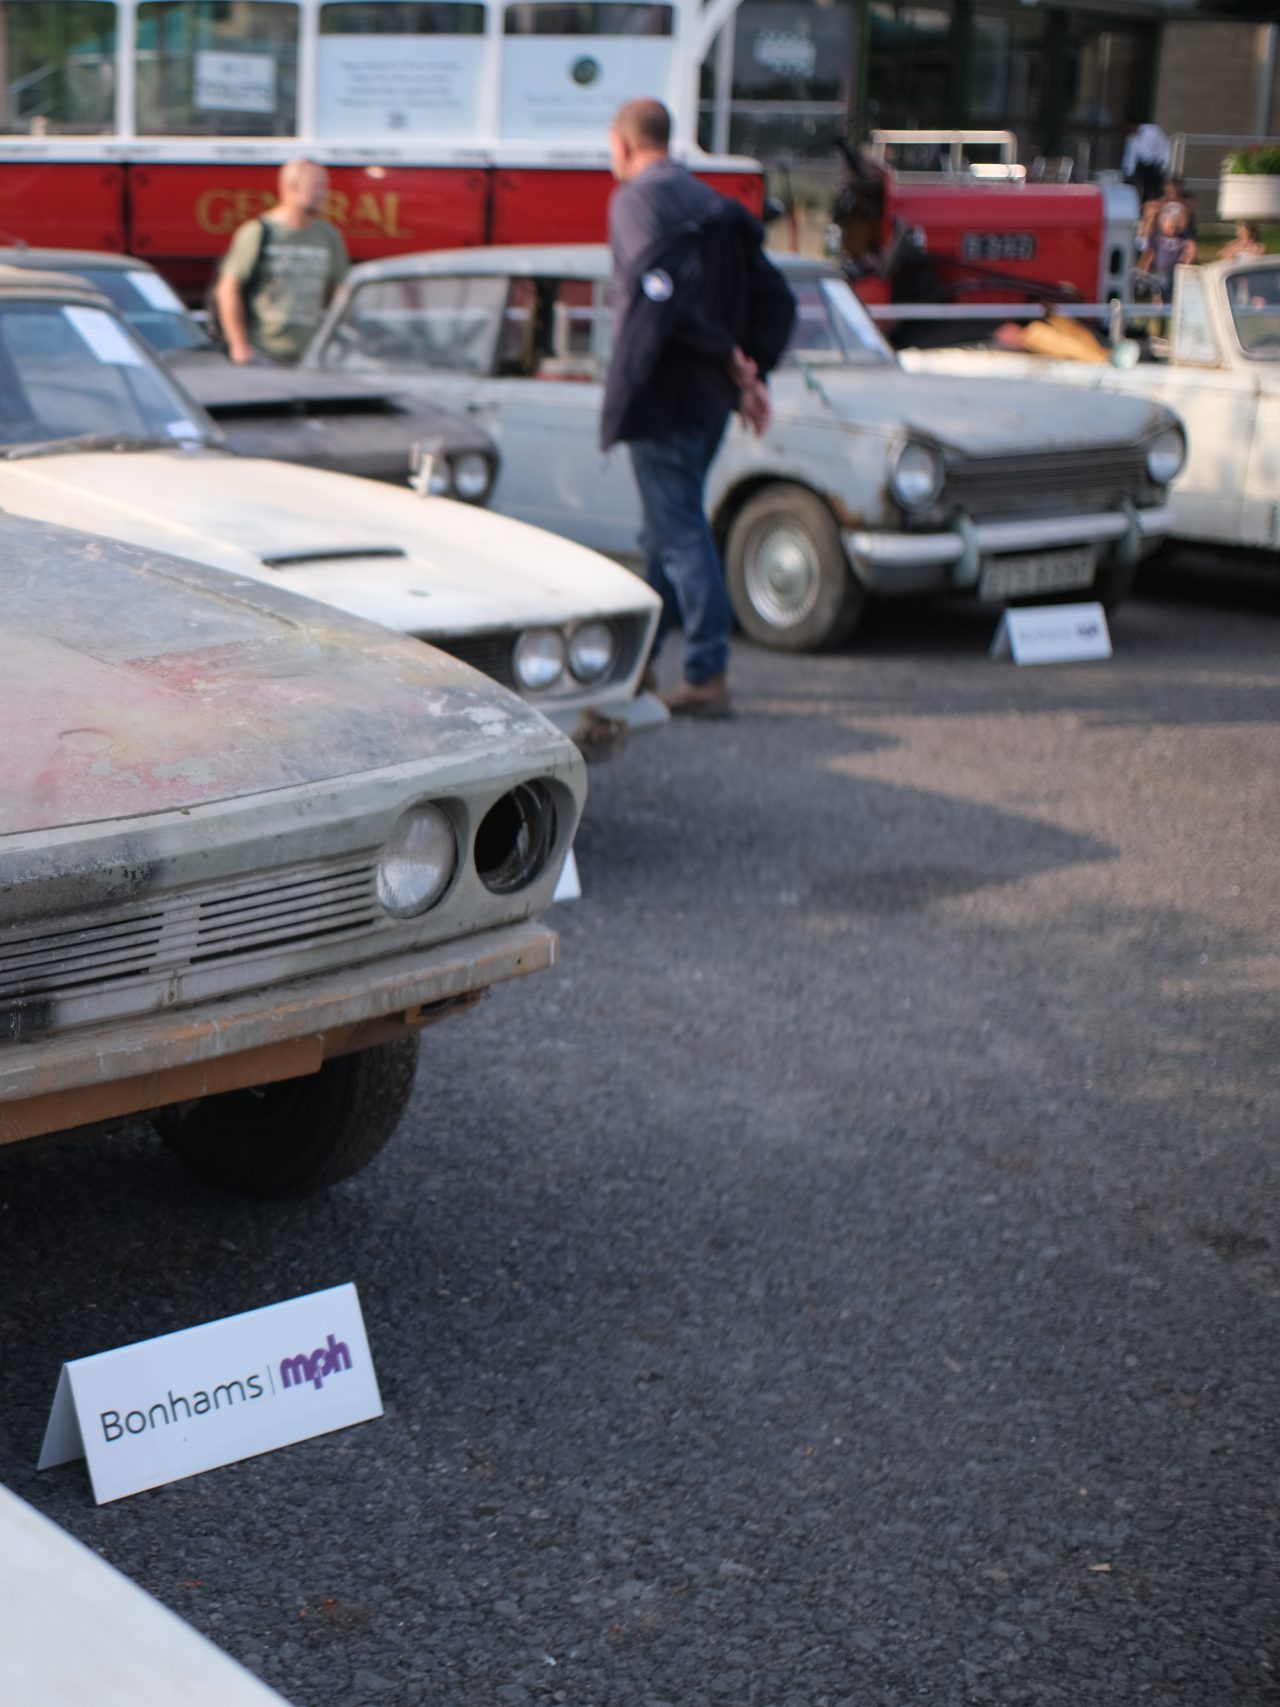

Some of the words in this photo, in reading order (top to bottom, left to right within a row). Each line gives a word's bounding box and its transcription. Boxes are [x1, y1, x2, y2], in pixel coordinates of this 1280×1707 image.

[196, 188, 414, 238] GERAL
[100, 1373, 263, 1442] Bonhams
[280, 1334, 353, 1390] mph
